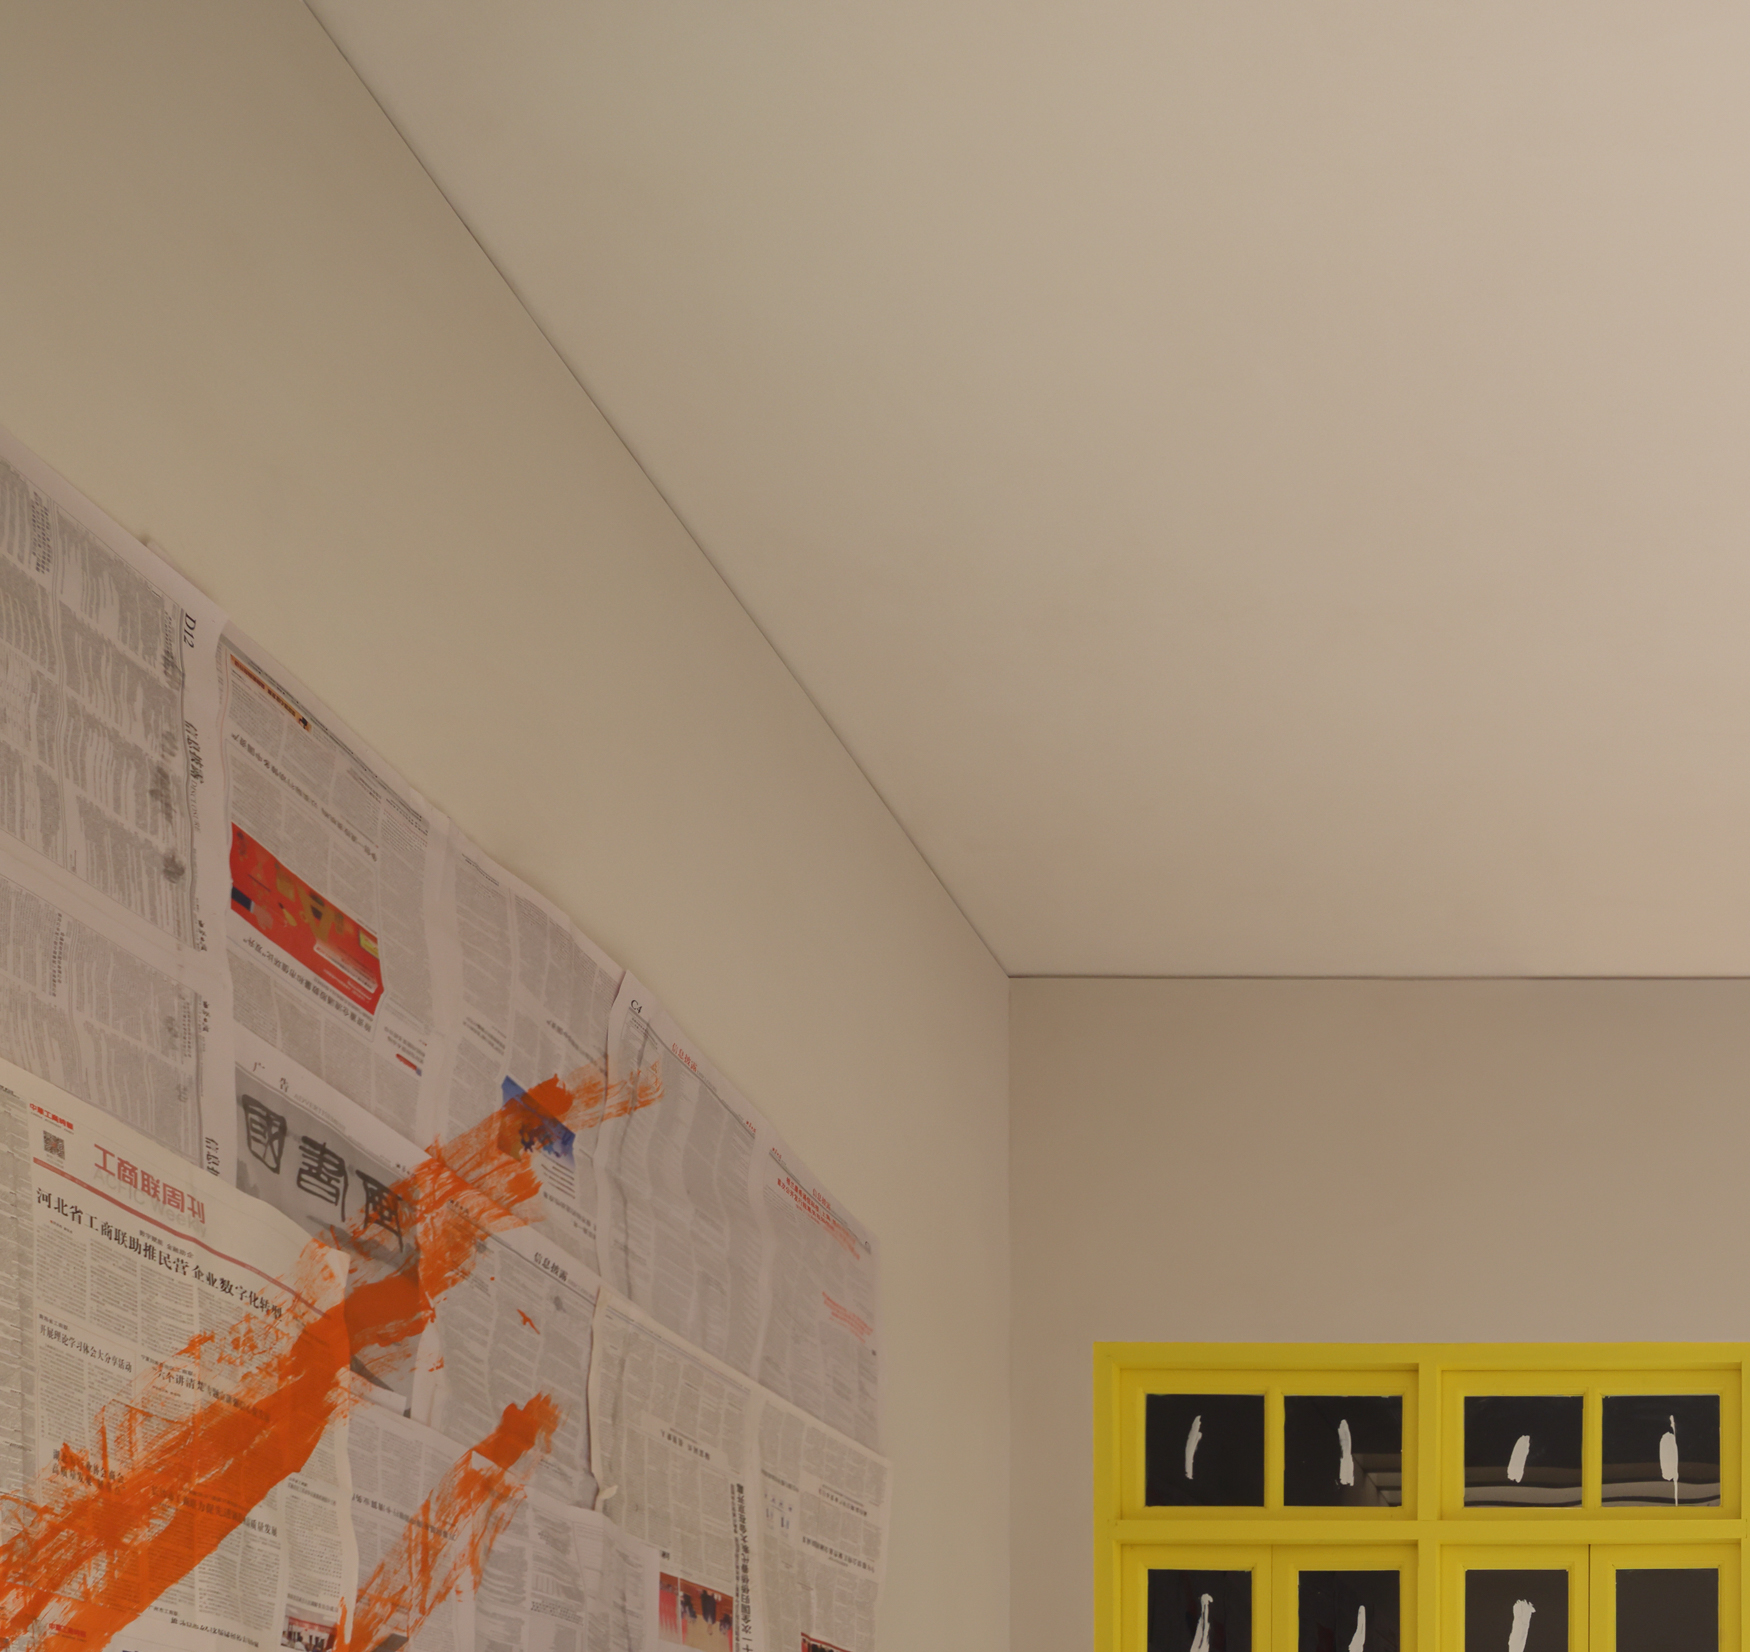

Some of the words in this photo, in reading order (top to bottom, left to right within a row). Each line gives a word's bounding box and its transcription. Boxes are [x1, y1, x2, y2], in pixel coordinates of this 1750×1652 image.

[183, 611, 197, 649] D12
[630, 1000, 643, 1014] C4
[94, 1143, 206, 1224] 工商联周刊
